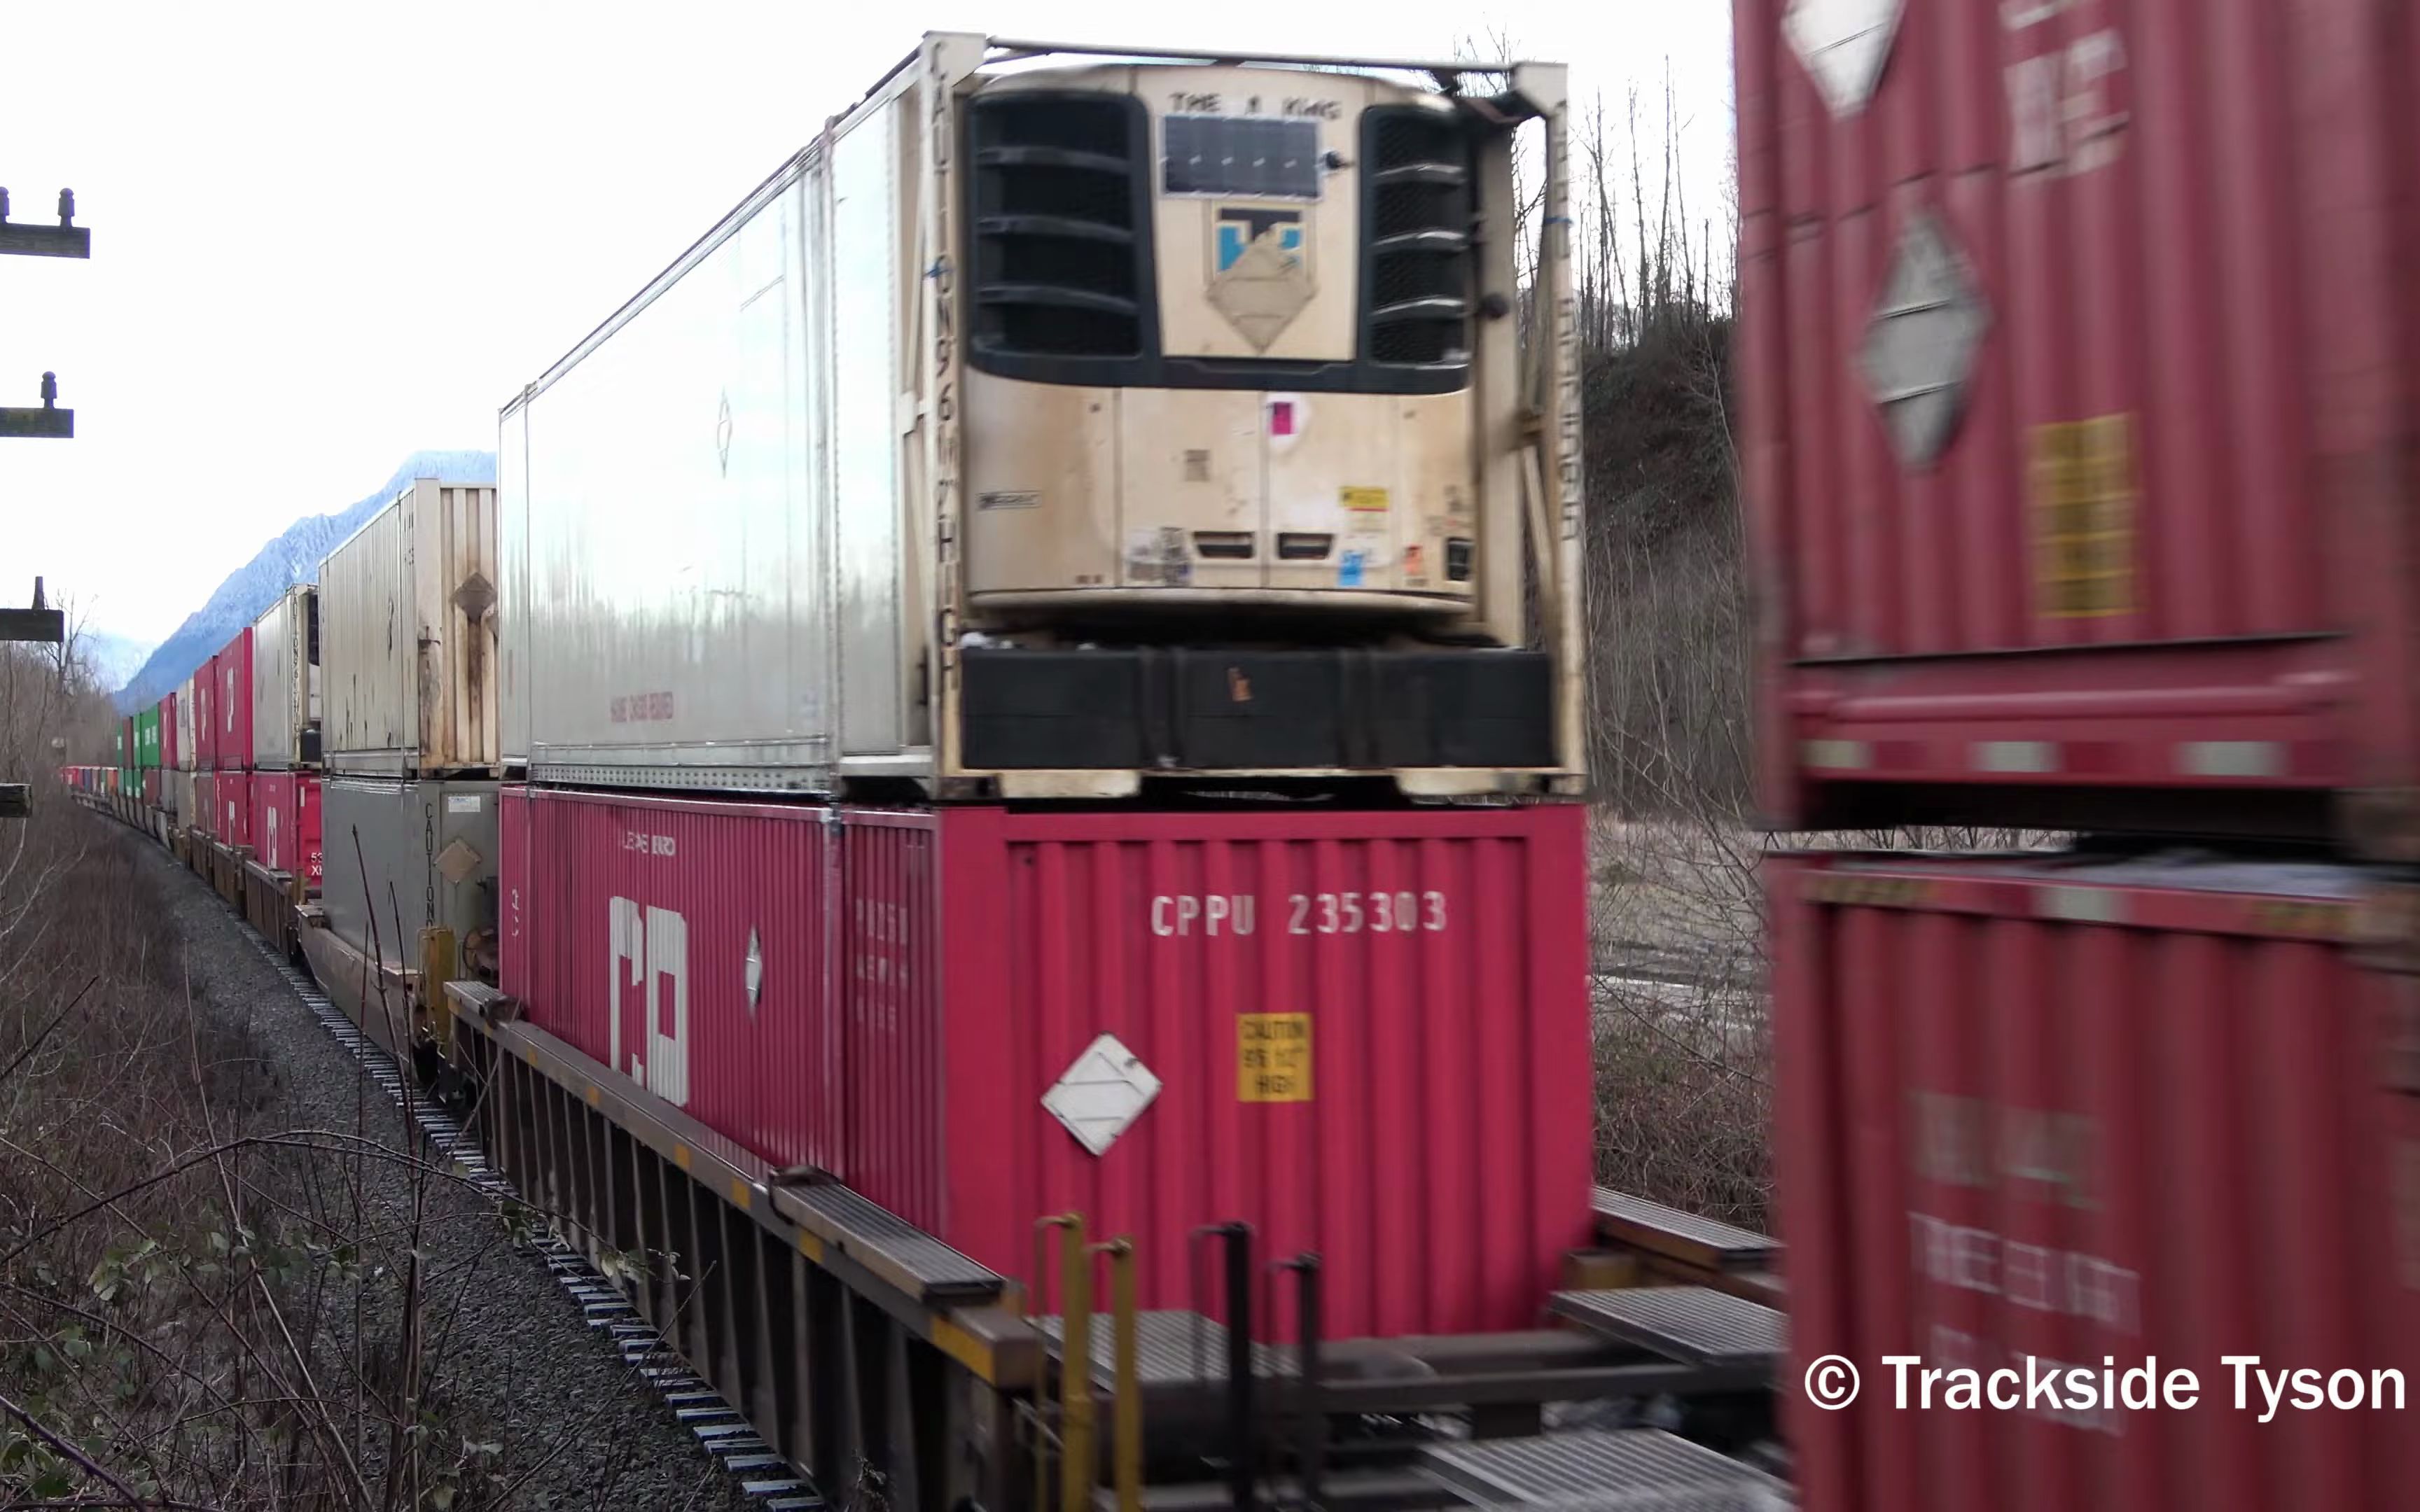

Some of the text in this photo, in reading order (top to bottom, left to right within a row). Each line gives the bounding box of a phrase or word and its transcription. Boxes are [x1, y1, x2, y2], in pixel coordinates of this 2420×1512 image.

[425, 803, 435, 921] CAUTION
[1150, 890, 1447, 937] CPPU 235303
